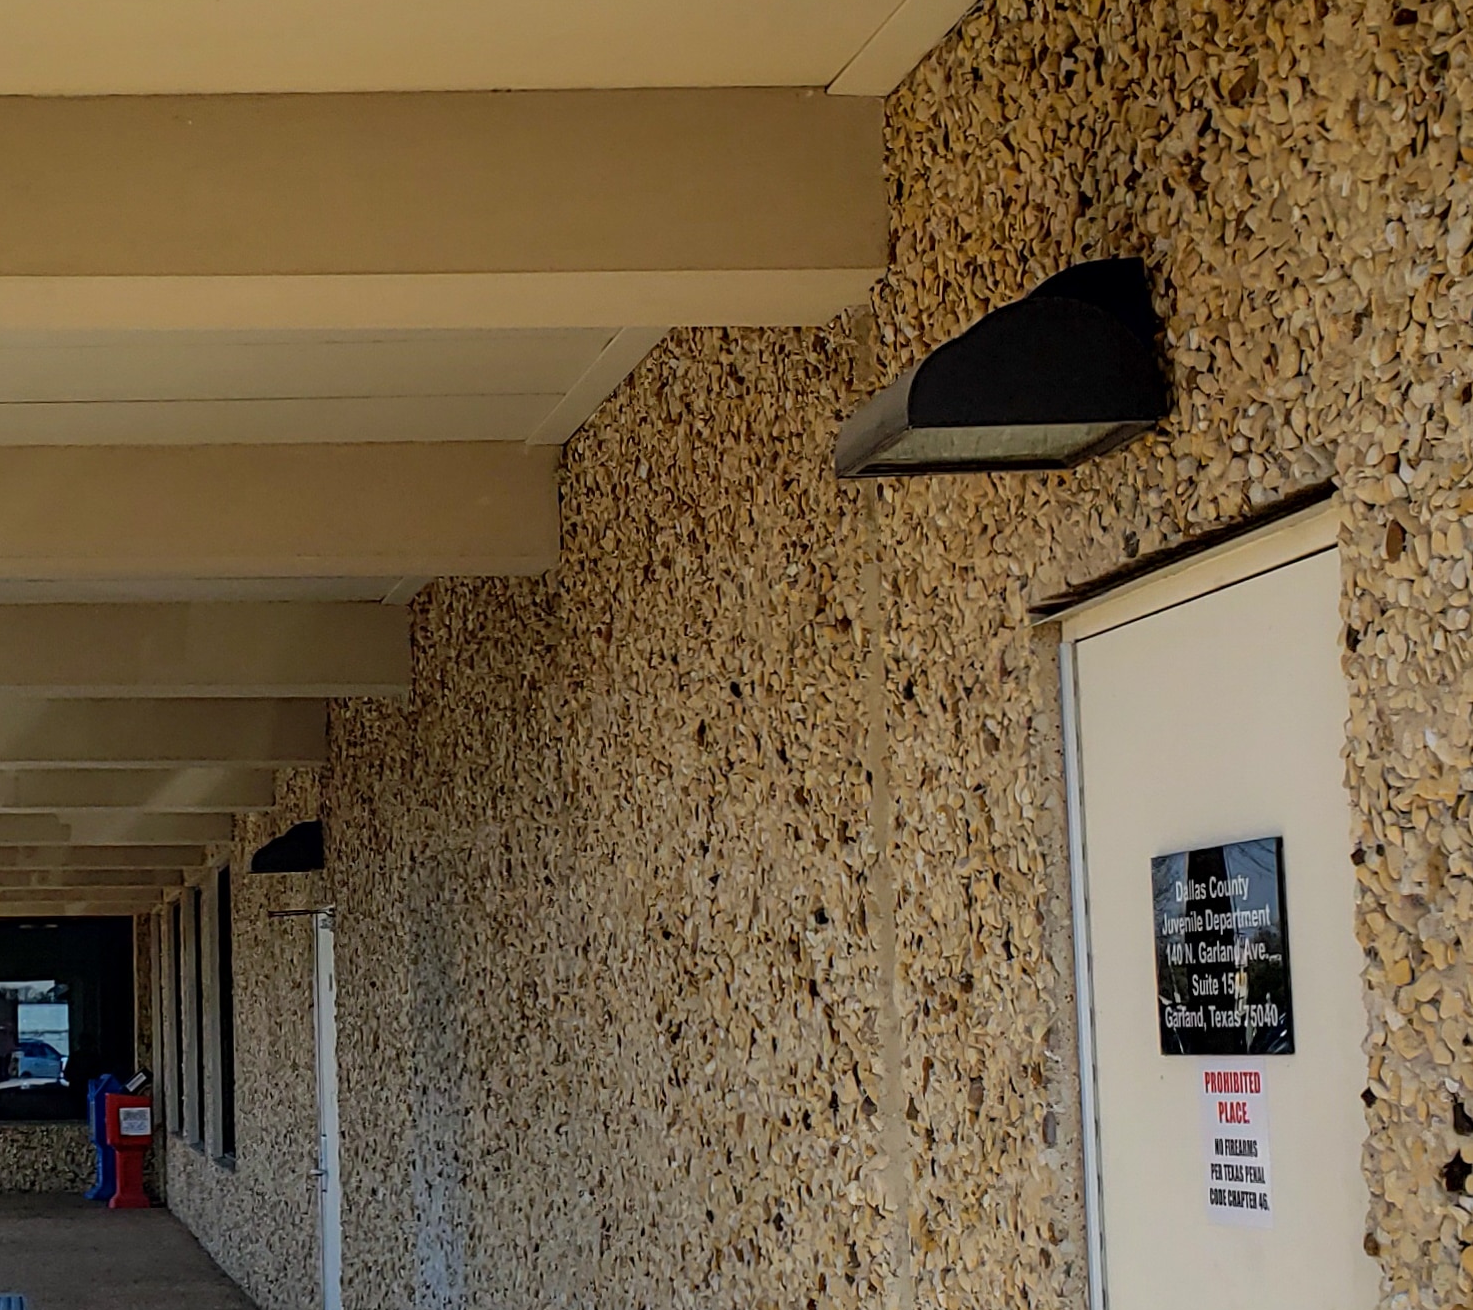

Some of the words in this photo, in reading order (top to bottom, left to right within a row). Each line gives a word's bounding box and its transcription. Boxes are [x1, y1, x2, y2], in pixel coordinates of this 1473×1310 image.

[1175, 879, 1207, 902] Dallas
[1209, 875, 1249, 900] County
[1162, 911, 1203, 936] Juvenile
[1205, 903, 1271, 935] Department
[1167, 942, 1183, 966] 140
[1185, 942, 1196, 964] N.
[1198, 939, 1241, 964] Garland
[1245, 937, 1270, 961] Ave.
[1192, 973, 1219, 996] Suite
[1165, 1005, 1207, 1032] Garland,
[1208, 1005, 1241, 1028] Texas
[1244, 1003, 1279, 1028] 75040
[1204, 1071, 1261, 1094] PROHIBITED
[1217, 1101, 1250, 1124] PLACE.
[1214, 1138, 1224, 1156] NO
[1224, 1139, 1258, 1158] FIREARMS
[1210, 1163, 1223, 1181] PER
[1223, 1164, 1244, 1183] TEXAS
[1245, 1166, 1266, 1184] PENAL
[1209, 1187, 1227, 1206] CODE
[1227, 1189, 1258, 1210] CHAPTER
